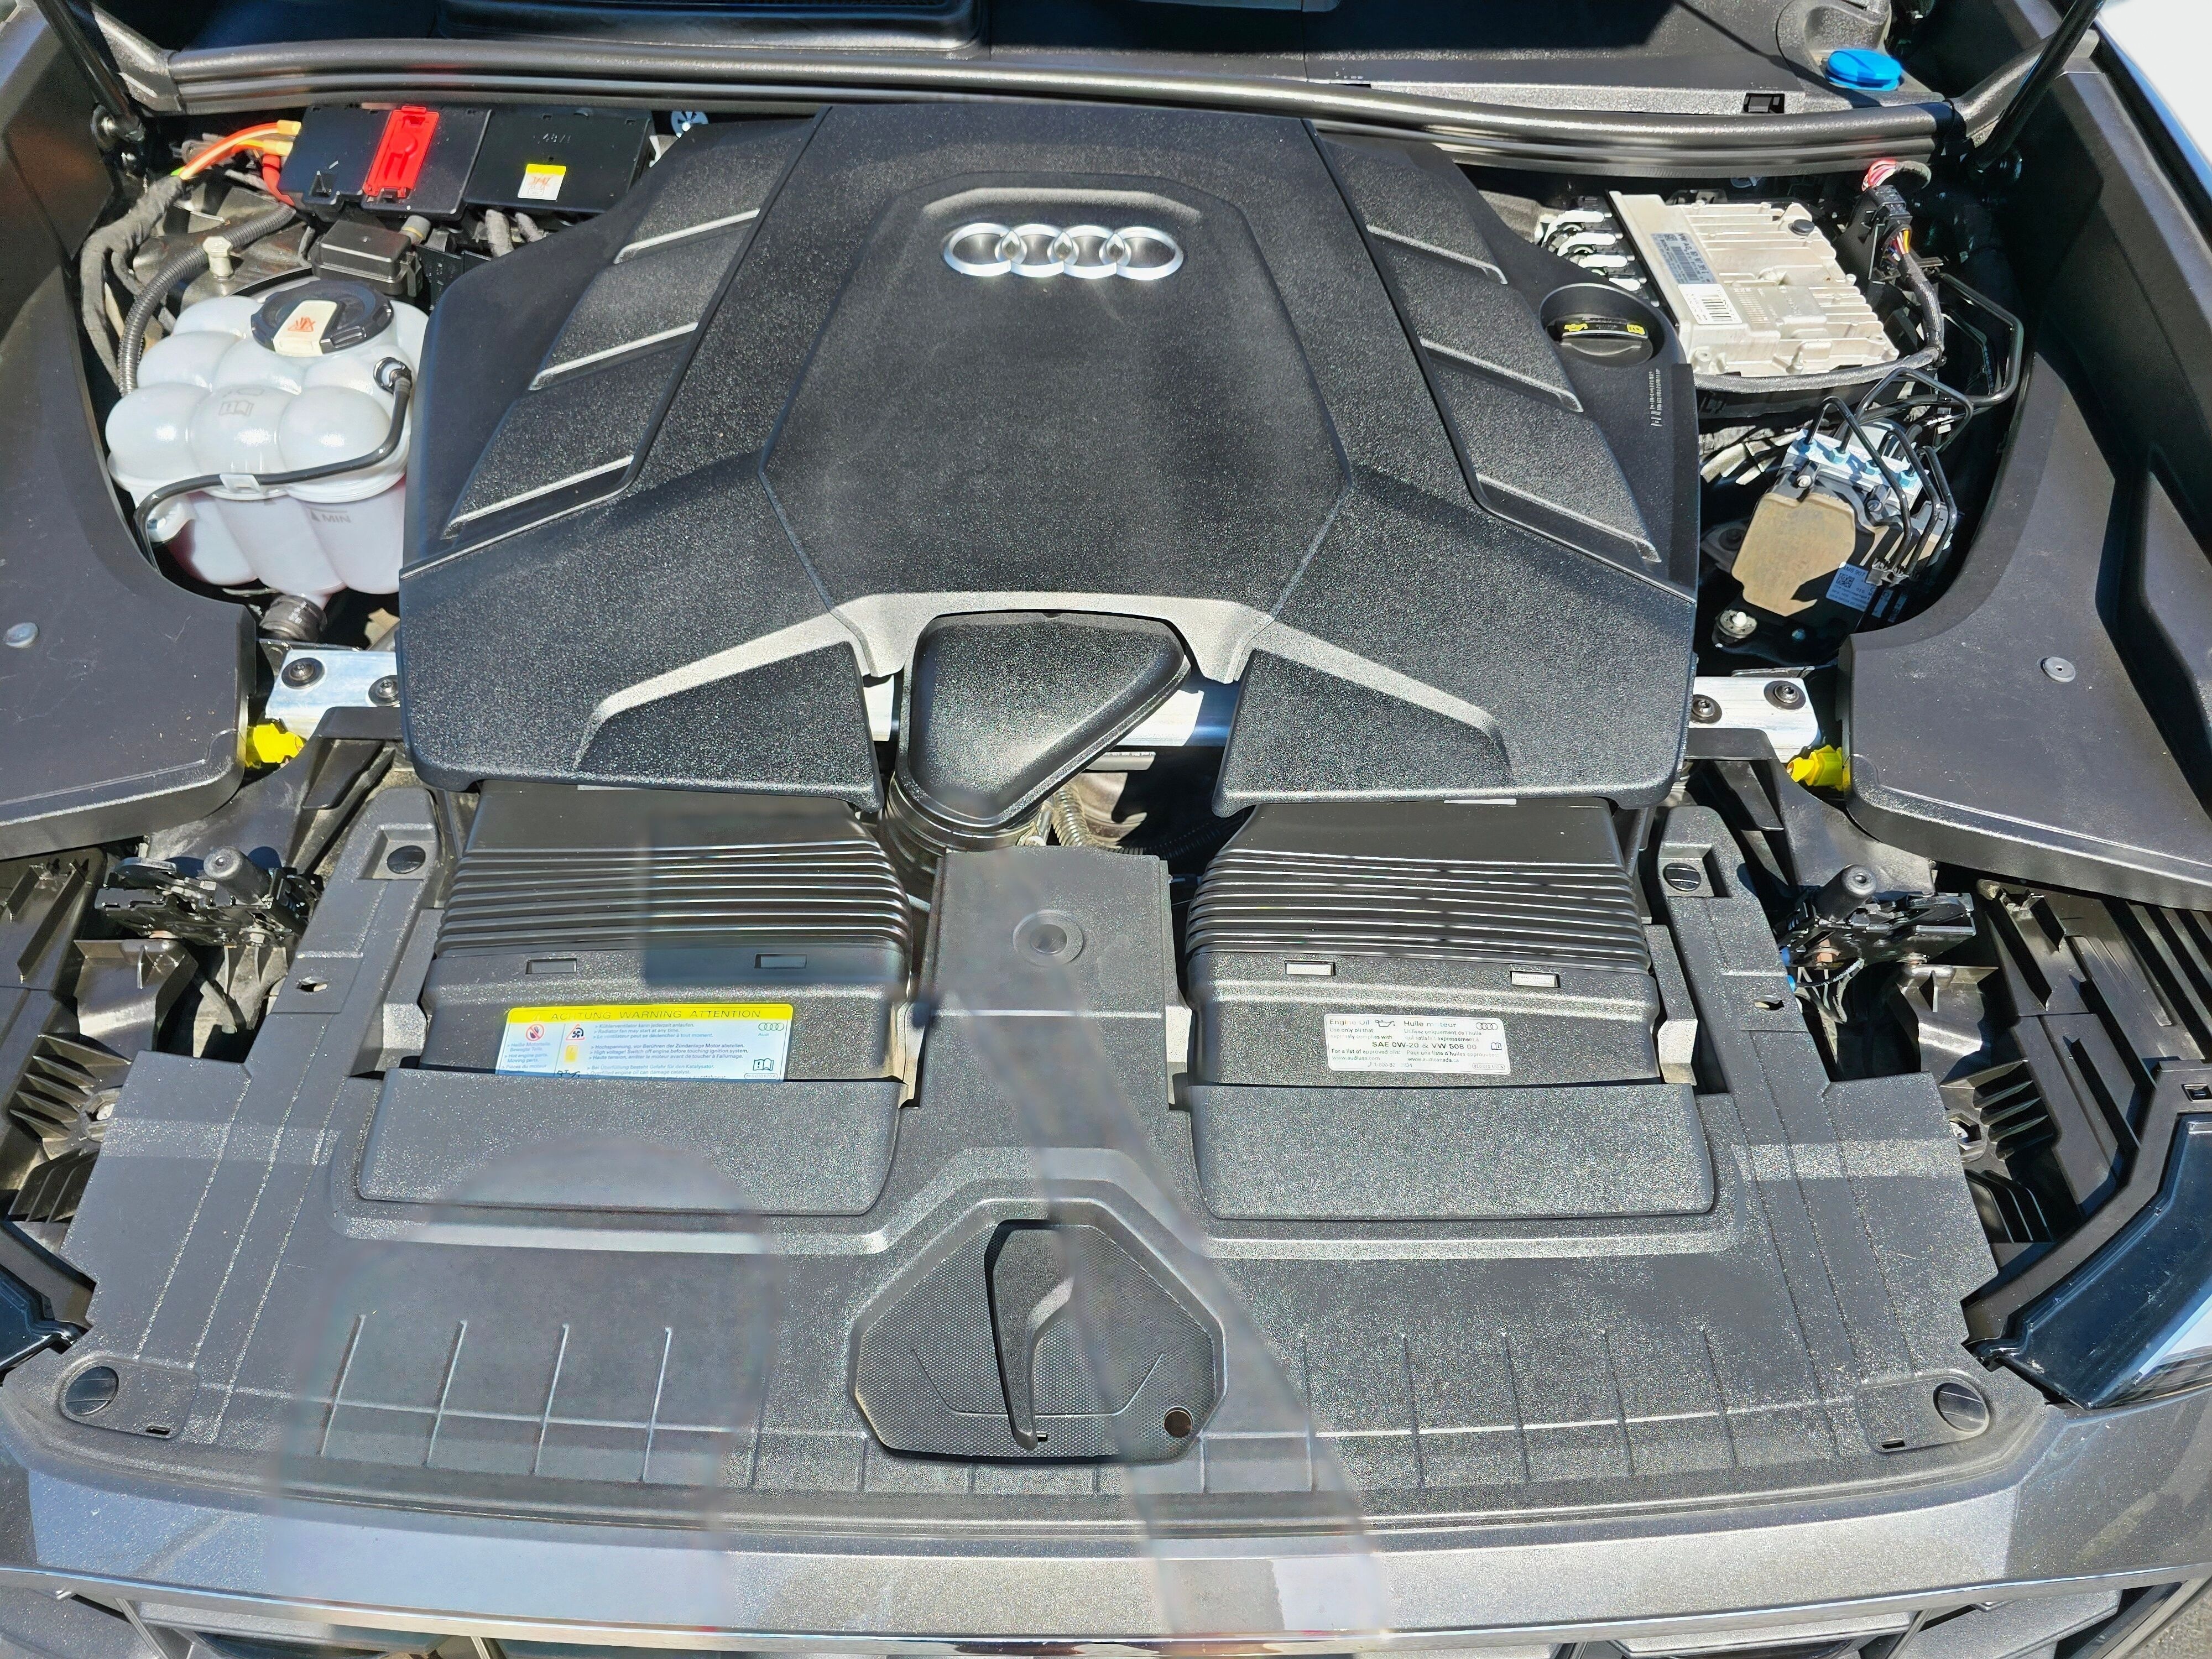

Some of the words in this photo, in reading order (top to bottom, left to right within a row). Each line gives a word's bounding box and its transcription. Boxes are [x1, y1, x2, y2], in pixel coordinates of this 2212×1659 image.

[321, 513, 351, 523] MIN
[550, 1011, 612, 1020] ACHTUNG
[619, 1010, 682, 1019] WARNING
[690, 1010, 761, 1018] ATTENTION
